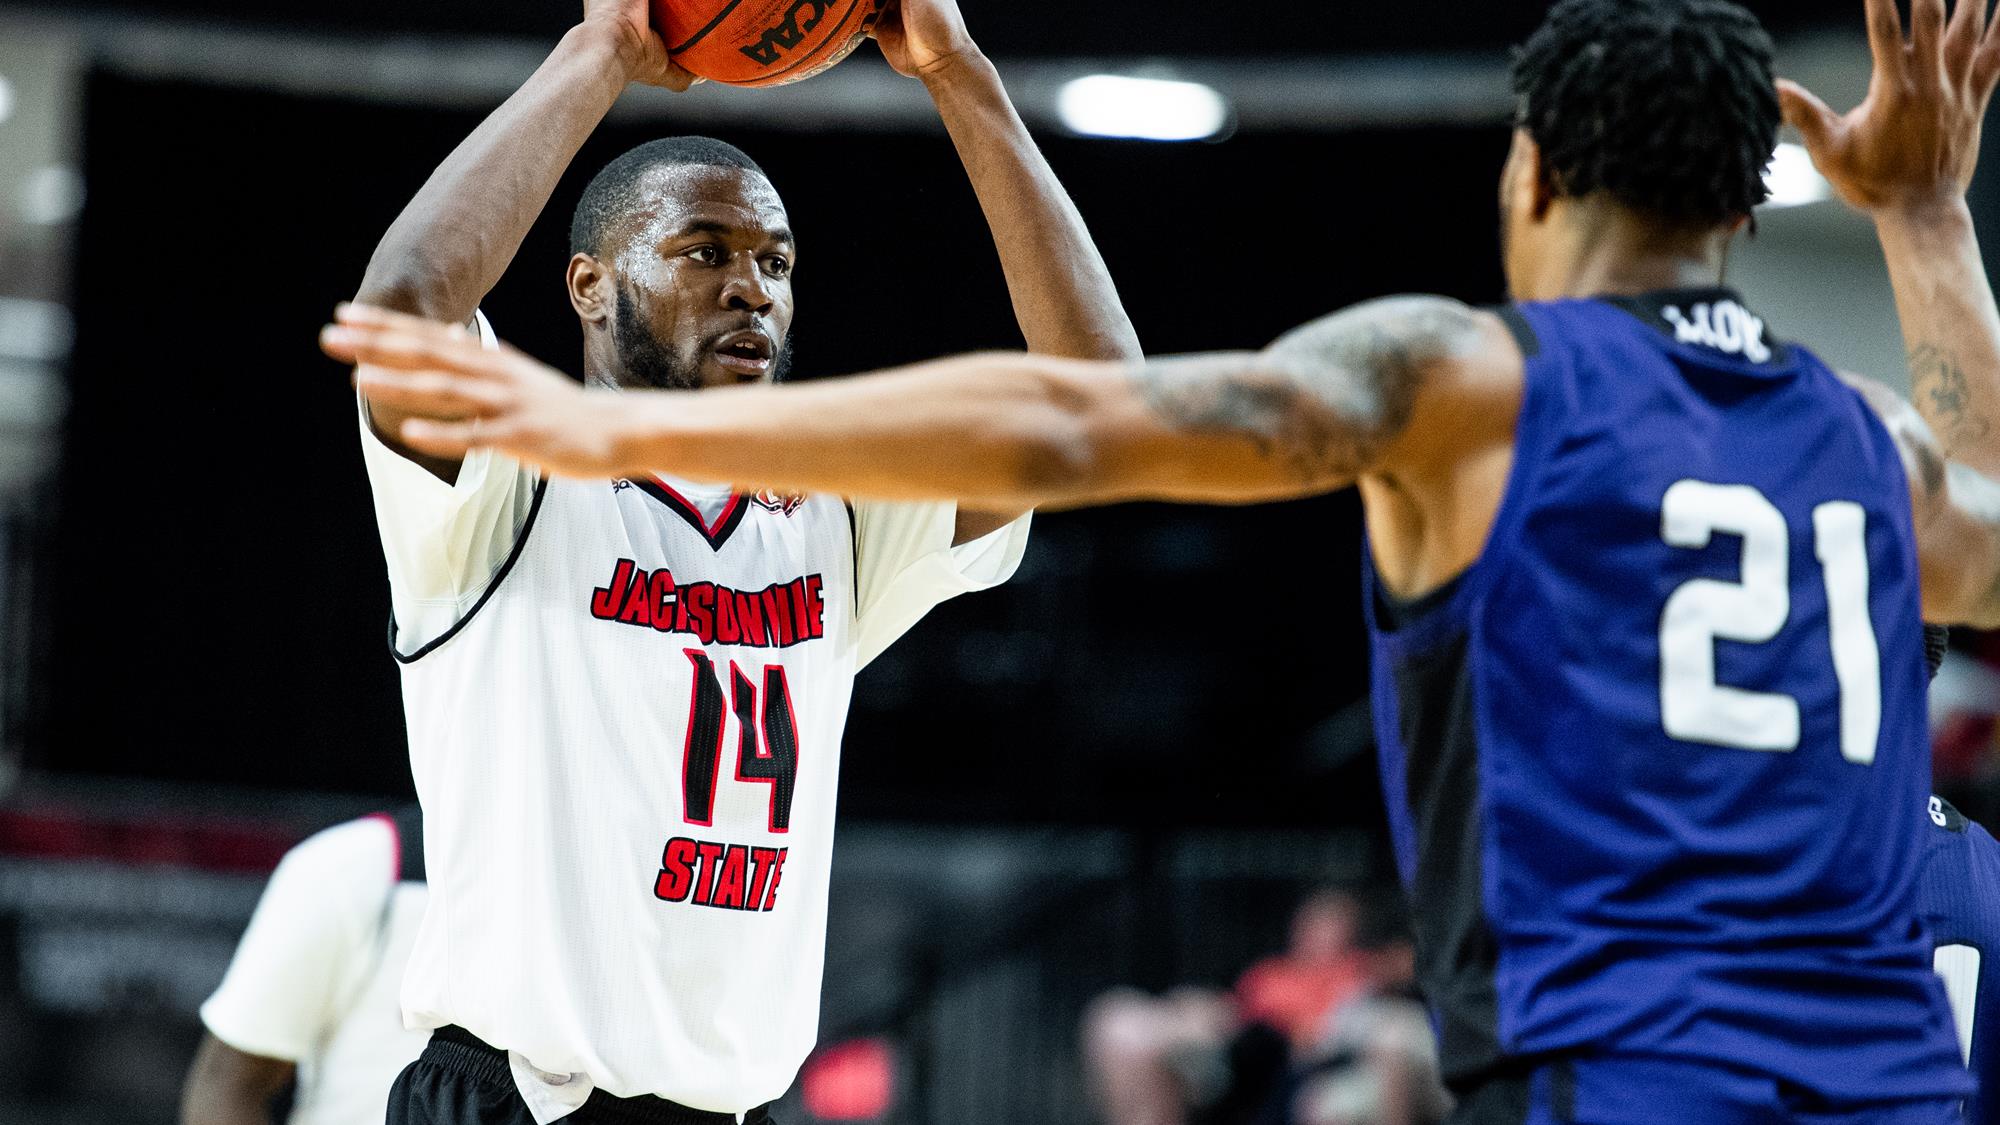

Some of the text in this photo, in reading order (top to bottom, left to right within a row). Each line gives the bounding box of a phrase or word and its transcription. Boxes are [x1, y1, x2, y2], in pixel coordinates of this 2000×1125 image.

[738, 0, 836, 66] CAA
[590, 558, 824, 648] JACKSONVILE
[1659, 478, 1882, 767] 21
[683, 648, 800, 833] 14
[653, 836, 788, 912] STATE
